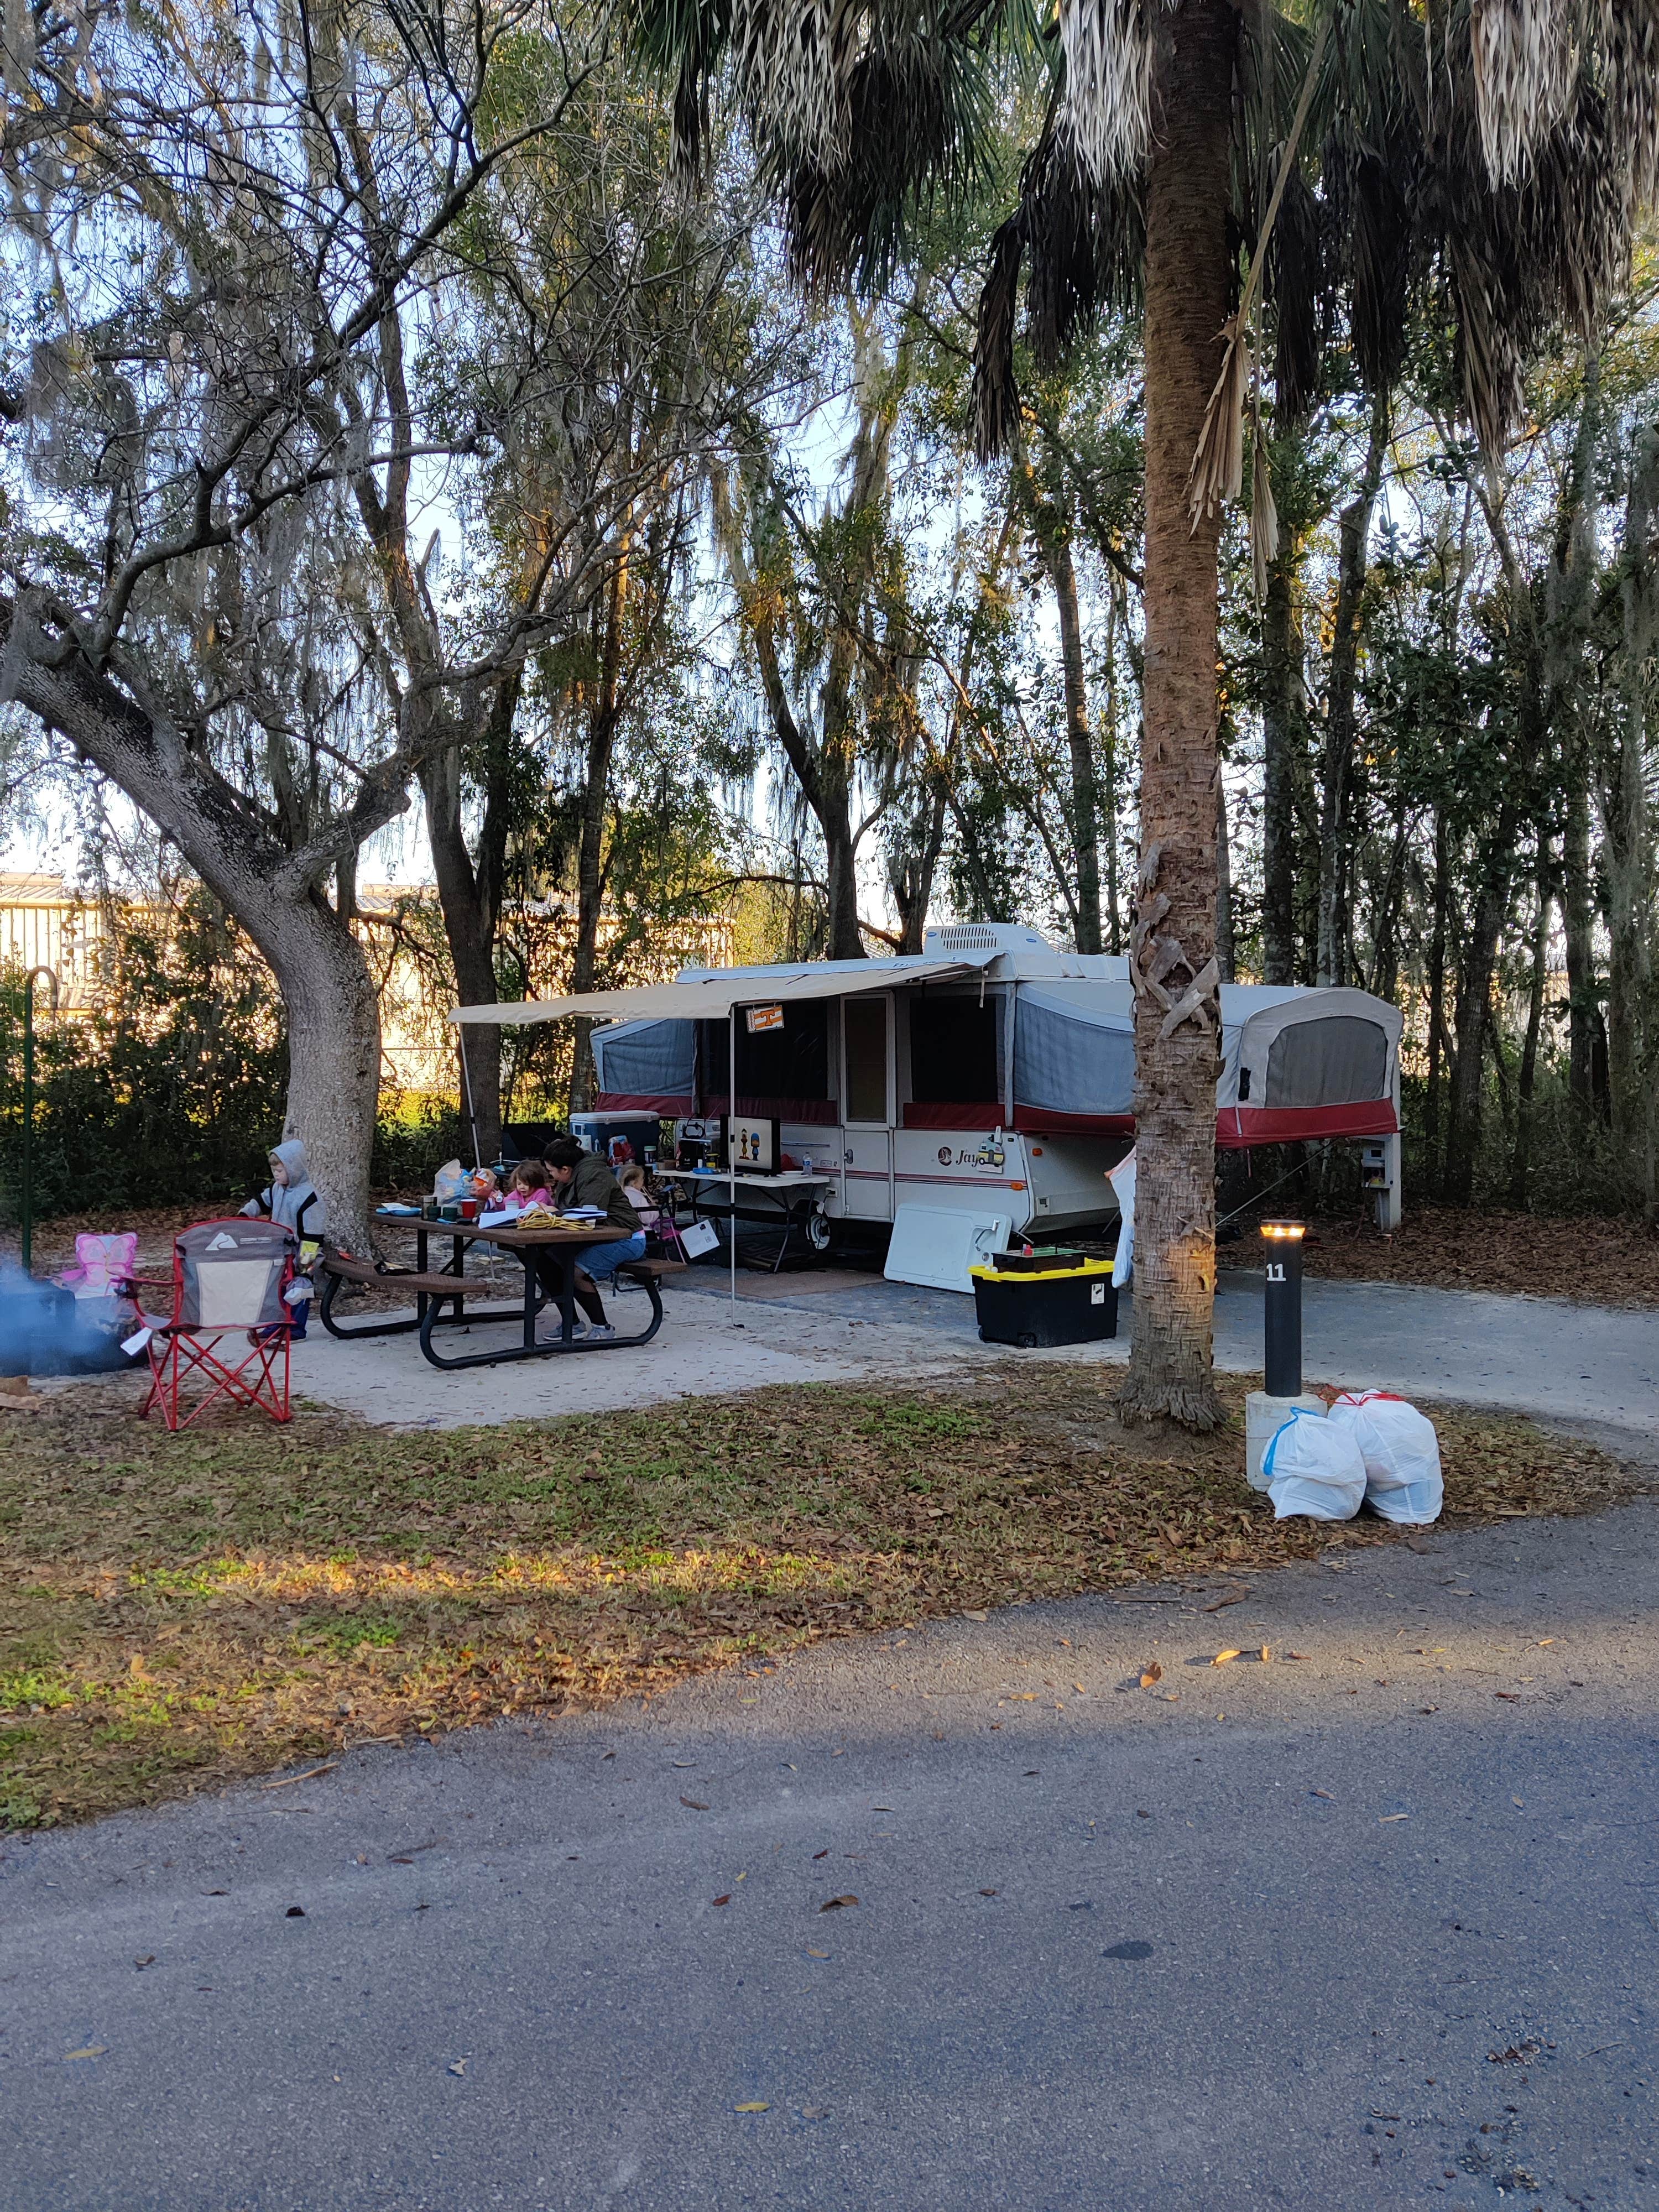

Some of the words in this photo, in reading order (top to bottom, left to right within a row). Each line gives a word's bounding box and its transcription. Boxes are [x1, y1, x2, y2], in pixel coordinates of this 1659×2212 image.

[760, 1009, 775, 1026] T
[956, 1150, 979, 1167] Jay
[1266, 1264, 1286, 1281] 11
